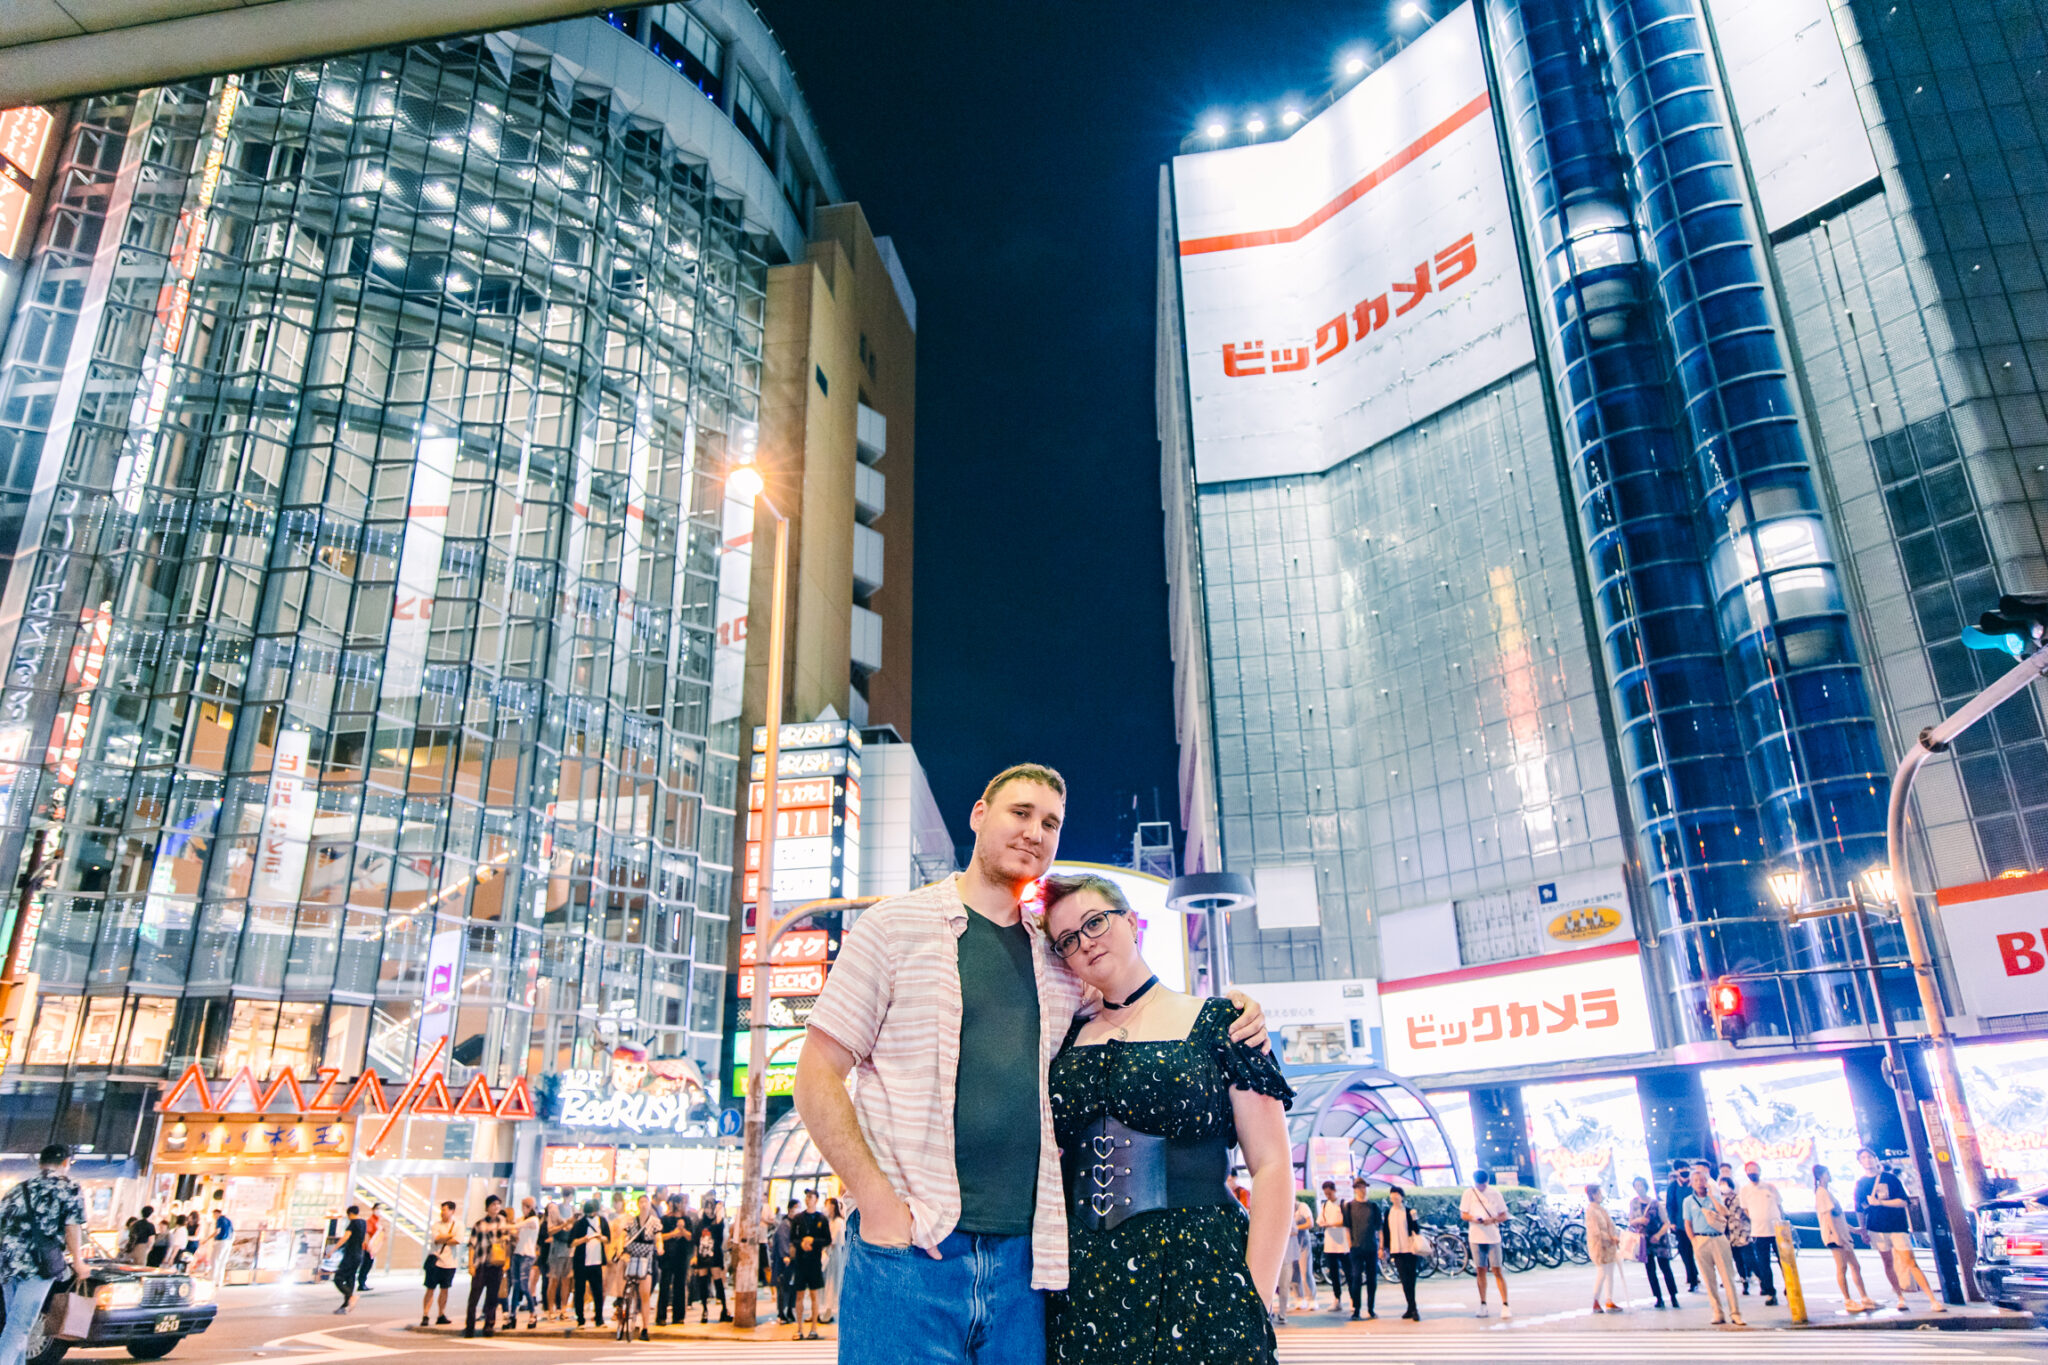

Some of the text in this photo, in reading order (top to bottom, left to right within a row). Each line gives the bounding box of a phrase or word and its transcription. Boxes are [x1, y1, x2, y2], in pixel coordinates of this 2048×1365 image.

[1222, 232, 1478, 378] ビックカメラ
[775, 972, 823, 990] ECHO
[1406, 988, 1620, 1050] ビックカメラ
